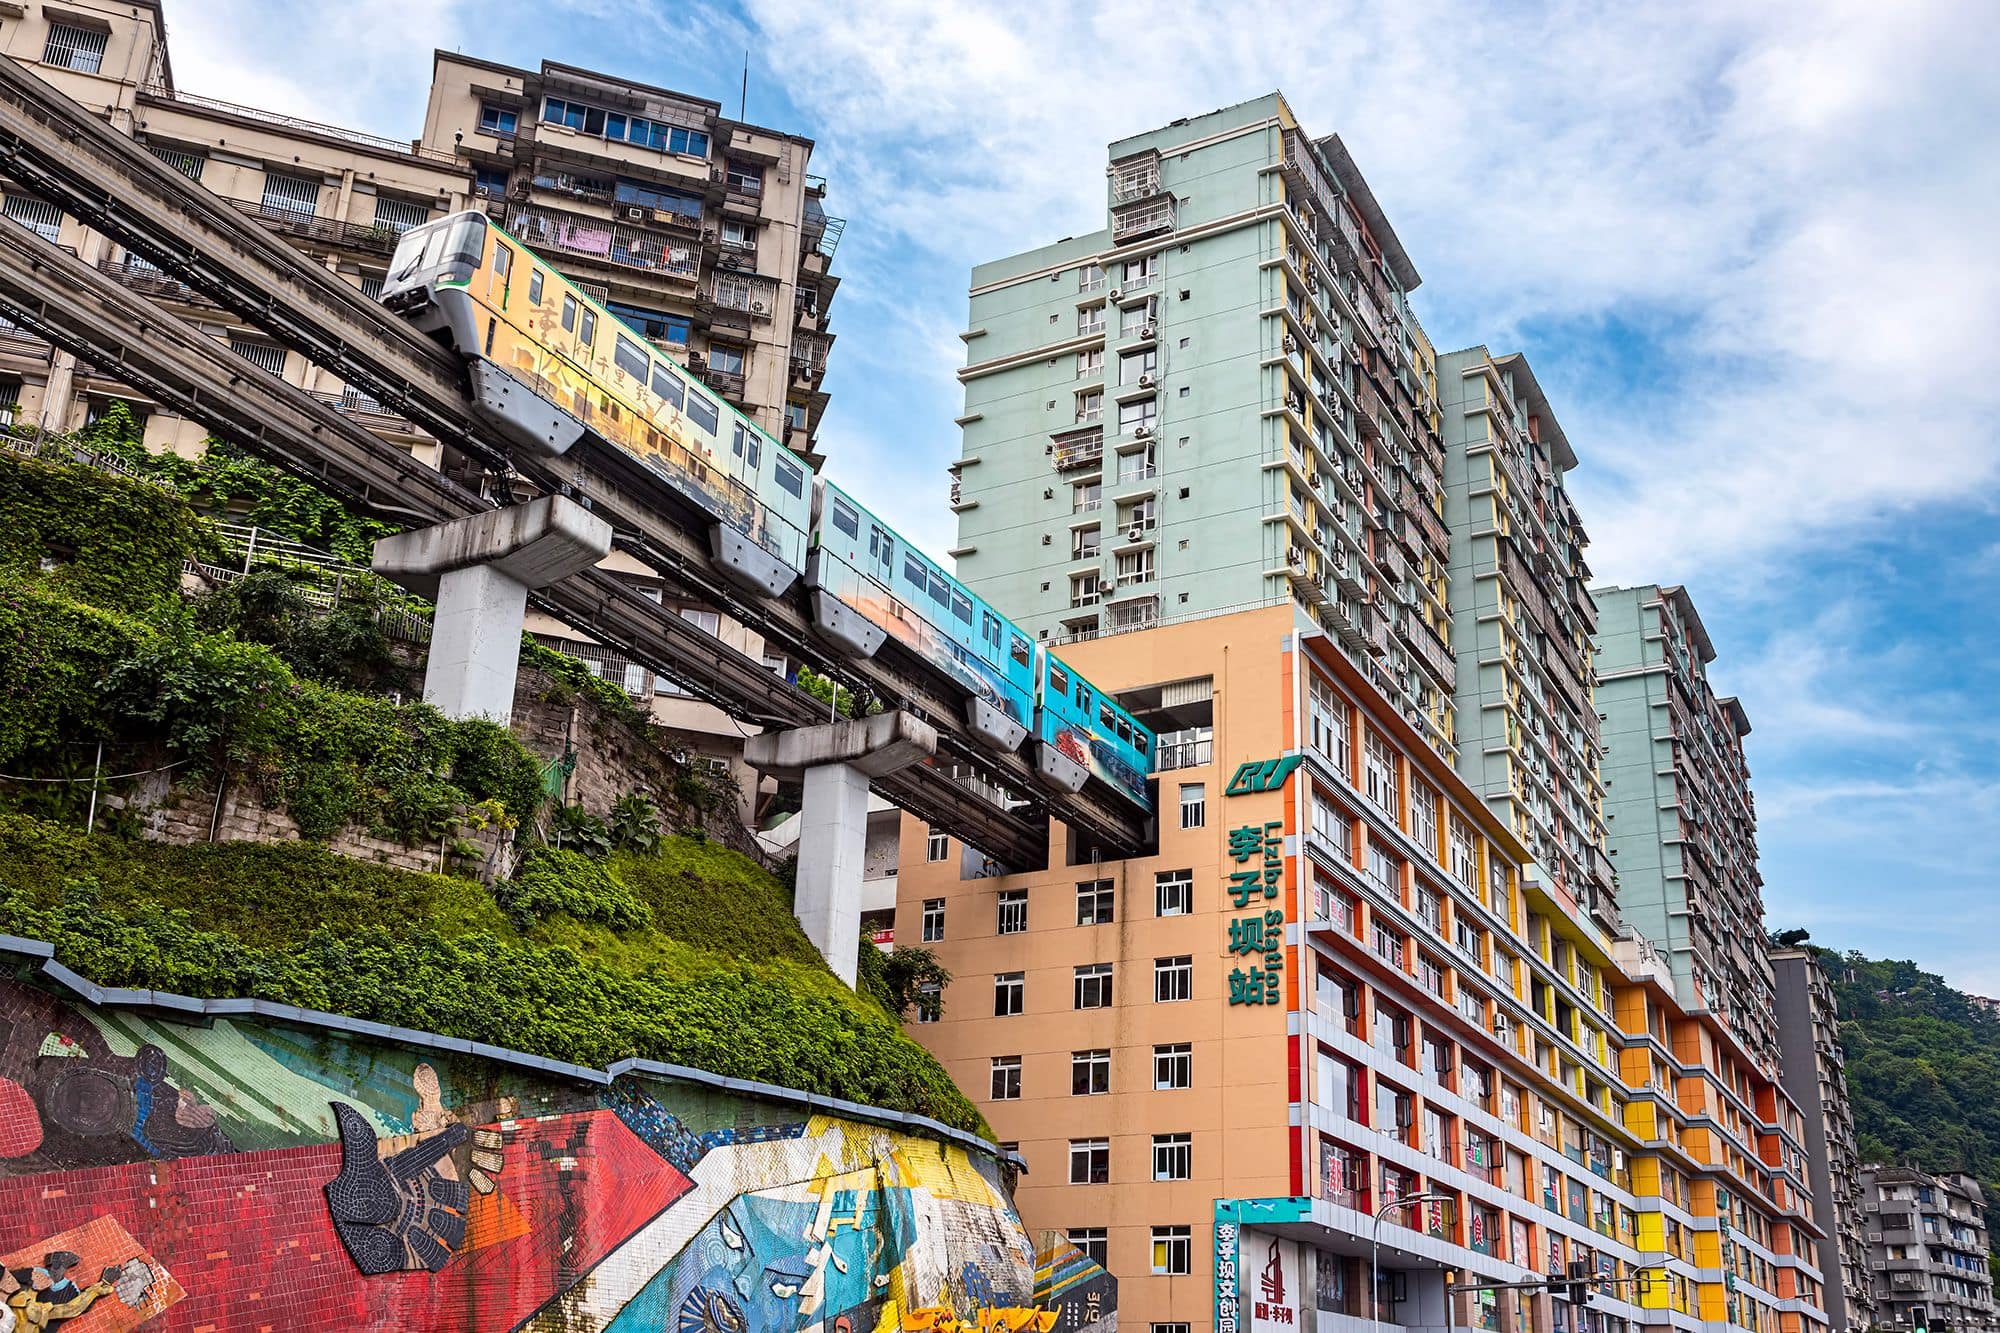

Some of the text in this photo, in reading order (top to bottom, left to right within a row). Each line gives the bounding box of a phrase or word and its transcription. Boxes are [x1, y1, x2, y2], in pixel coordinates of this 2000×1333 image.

[1228, 825, 1265, 1006] 李子坝站
[1264, 821, 1284, 1005] Liziba Station
[1217, 1223, 1236, 1333] 李子坝文创园
